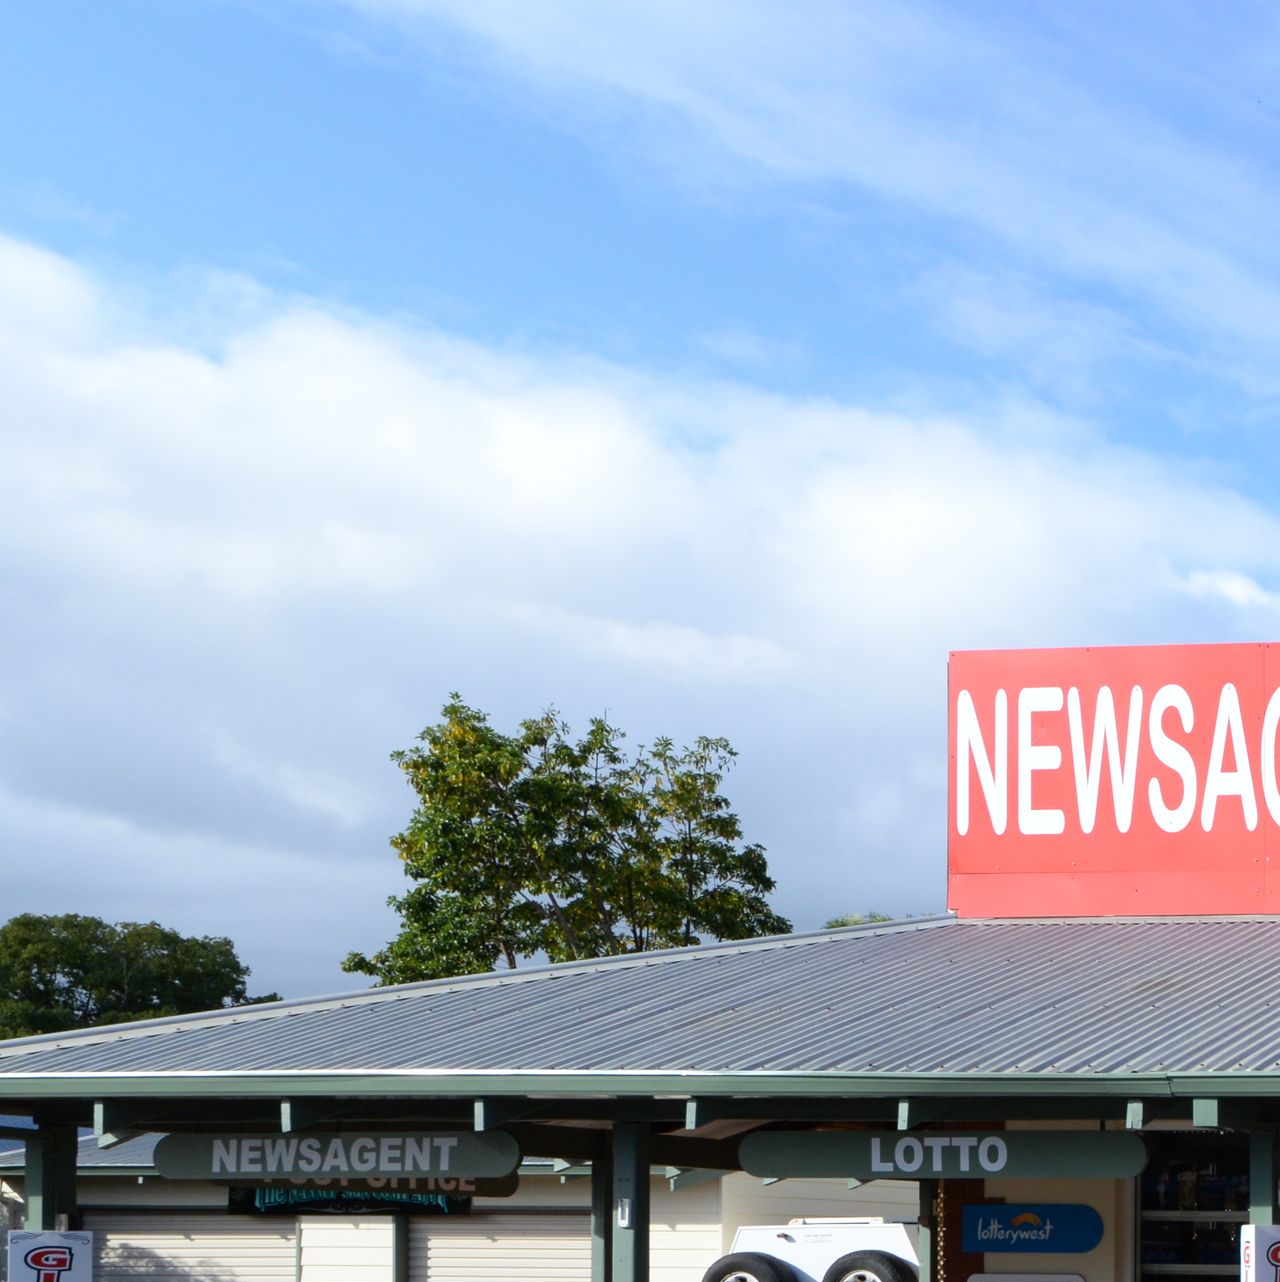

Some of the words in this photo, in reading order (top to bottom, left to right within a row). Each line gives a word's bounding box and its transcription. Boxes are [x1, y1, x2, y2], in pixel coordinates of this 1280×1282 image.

[211, 1137, 458, 1173] NEWSAGENT
[871, 1136, 1008, 1172] LOTTO
[977, 1217, 1053, 1244] lotterywest
